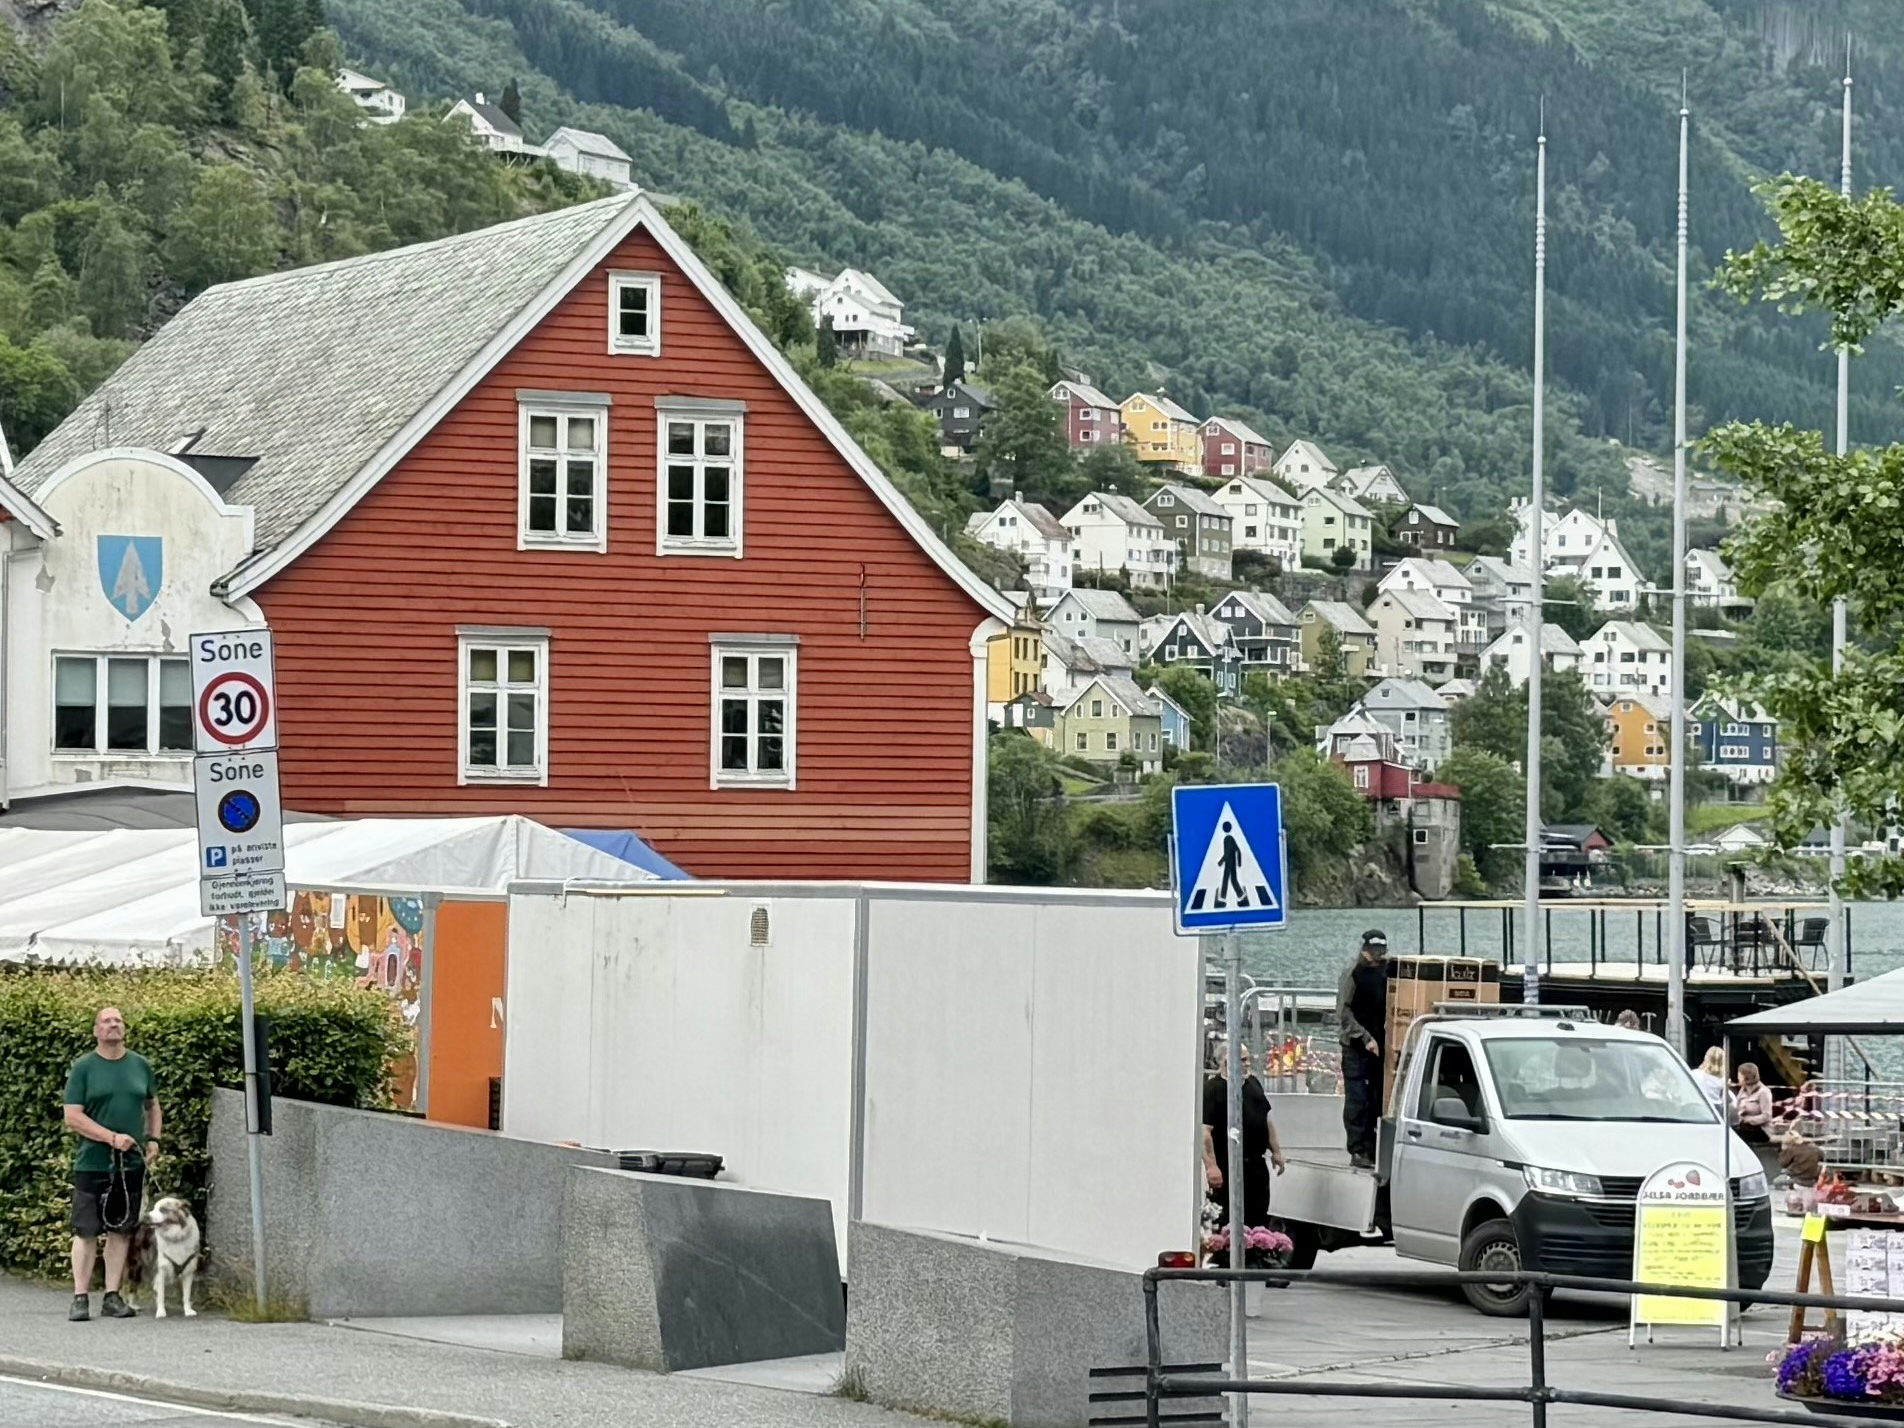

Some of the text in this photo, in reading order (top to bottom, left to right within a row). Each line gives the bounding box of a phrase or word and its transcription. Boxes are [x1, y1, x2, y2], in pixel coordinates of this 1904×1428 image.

[200, 639, 263, 663] Sone
[213, 690, 257, 727] 30
[210, 762, 265, 782] Sone
[210, 848, 223, 866] P
[231, 844, 243, 855] på
[232, 856, 263, 866] plasser
